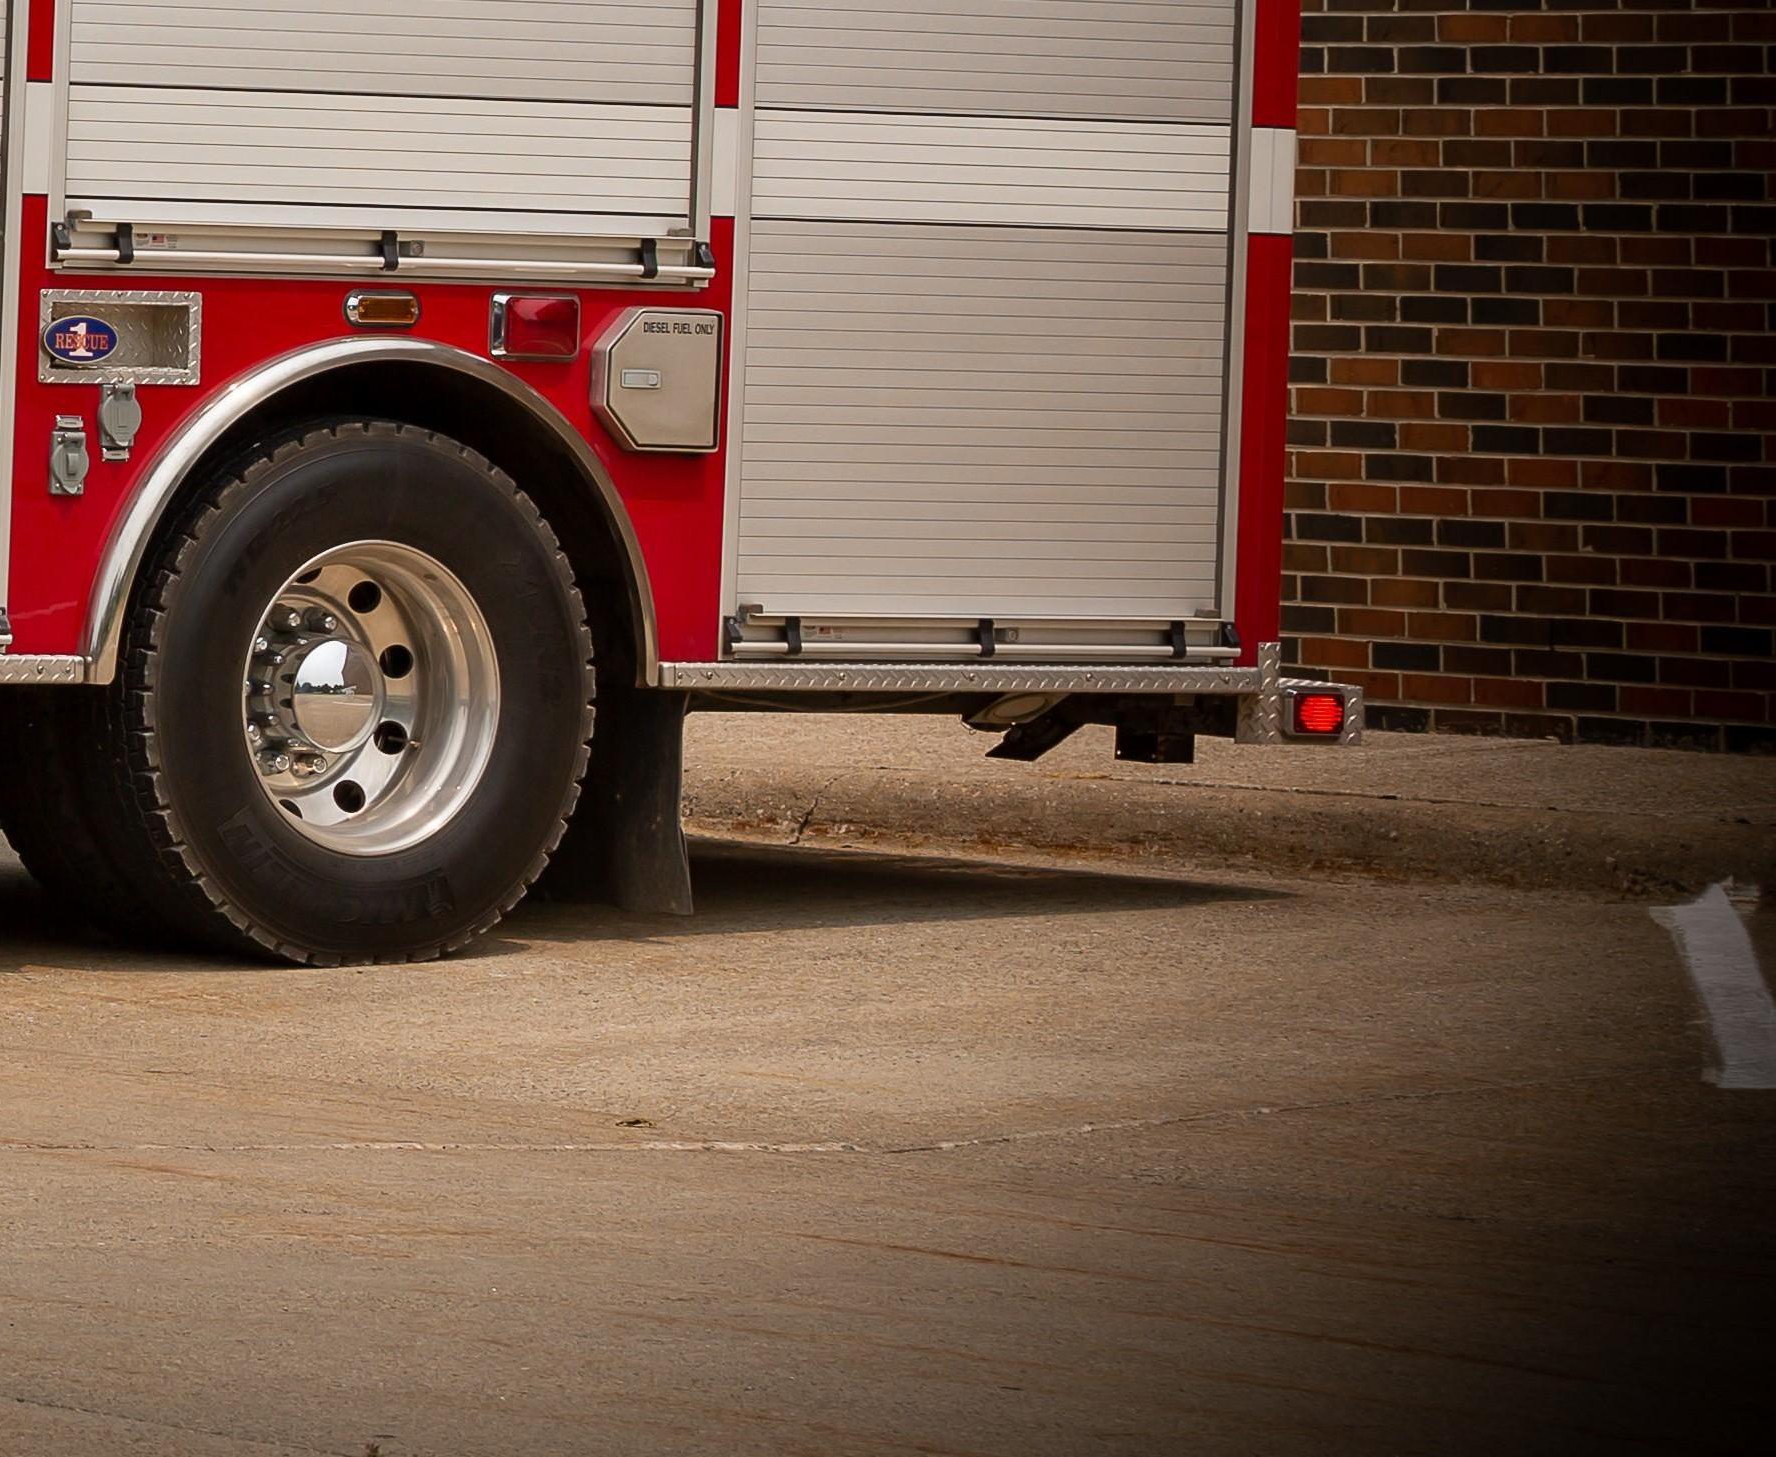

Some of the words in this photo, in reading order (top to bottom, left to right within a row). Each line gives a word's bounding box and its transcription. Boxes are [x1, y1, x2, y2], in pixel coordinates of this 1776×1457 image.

[643, 321, 670, 334] DIESEL
[673, 322, 692, 335] FUEL
[694, 322, 715, 335] ONLY
[55, 333, 109, 350] RESCUE
